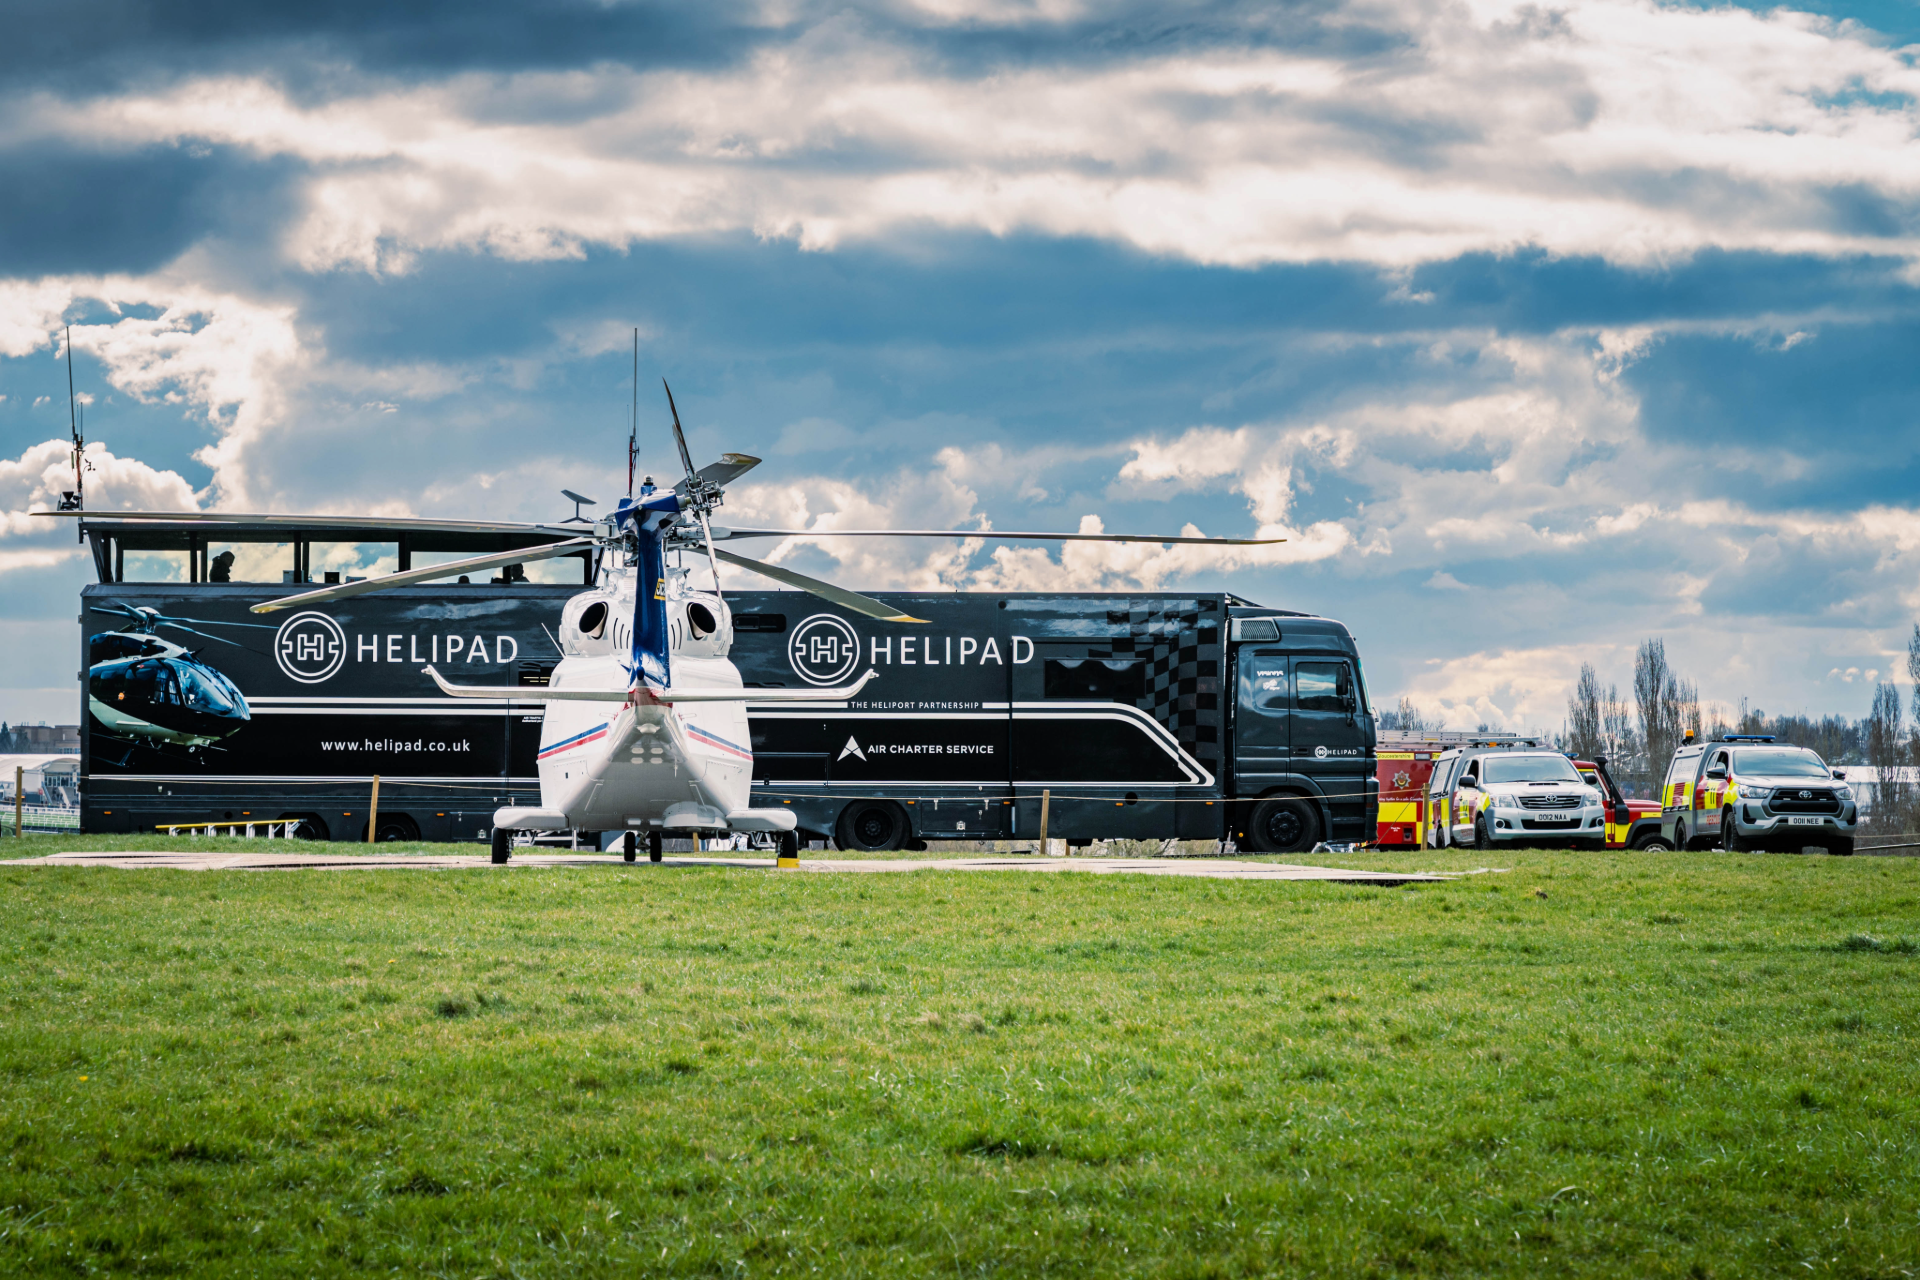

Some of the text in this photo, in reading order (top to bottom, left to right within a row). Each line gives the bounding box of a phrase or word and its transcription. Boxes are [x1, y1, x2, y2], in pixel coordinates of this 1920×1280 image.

[357, 634, 518, 663] HELIPAD
[870, 635, 1034, 665] HELIPAD
[850, 701, 979, 709] THE HELIPORT PARTNERSHIP
[321, 737, 471, 754] www.helipad.co.uk
[867, 744, 994, 754] AIR CHARTER SERVICE
[1554, 813, 1567, 821] NAA
[1806, 817, 1820, 825] NEE
